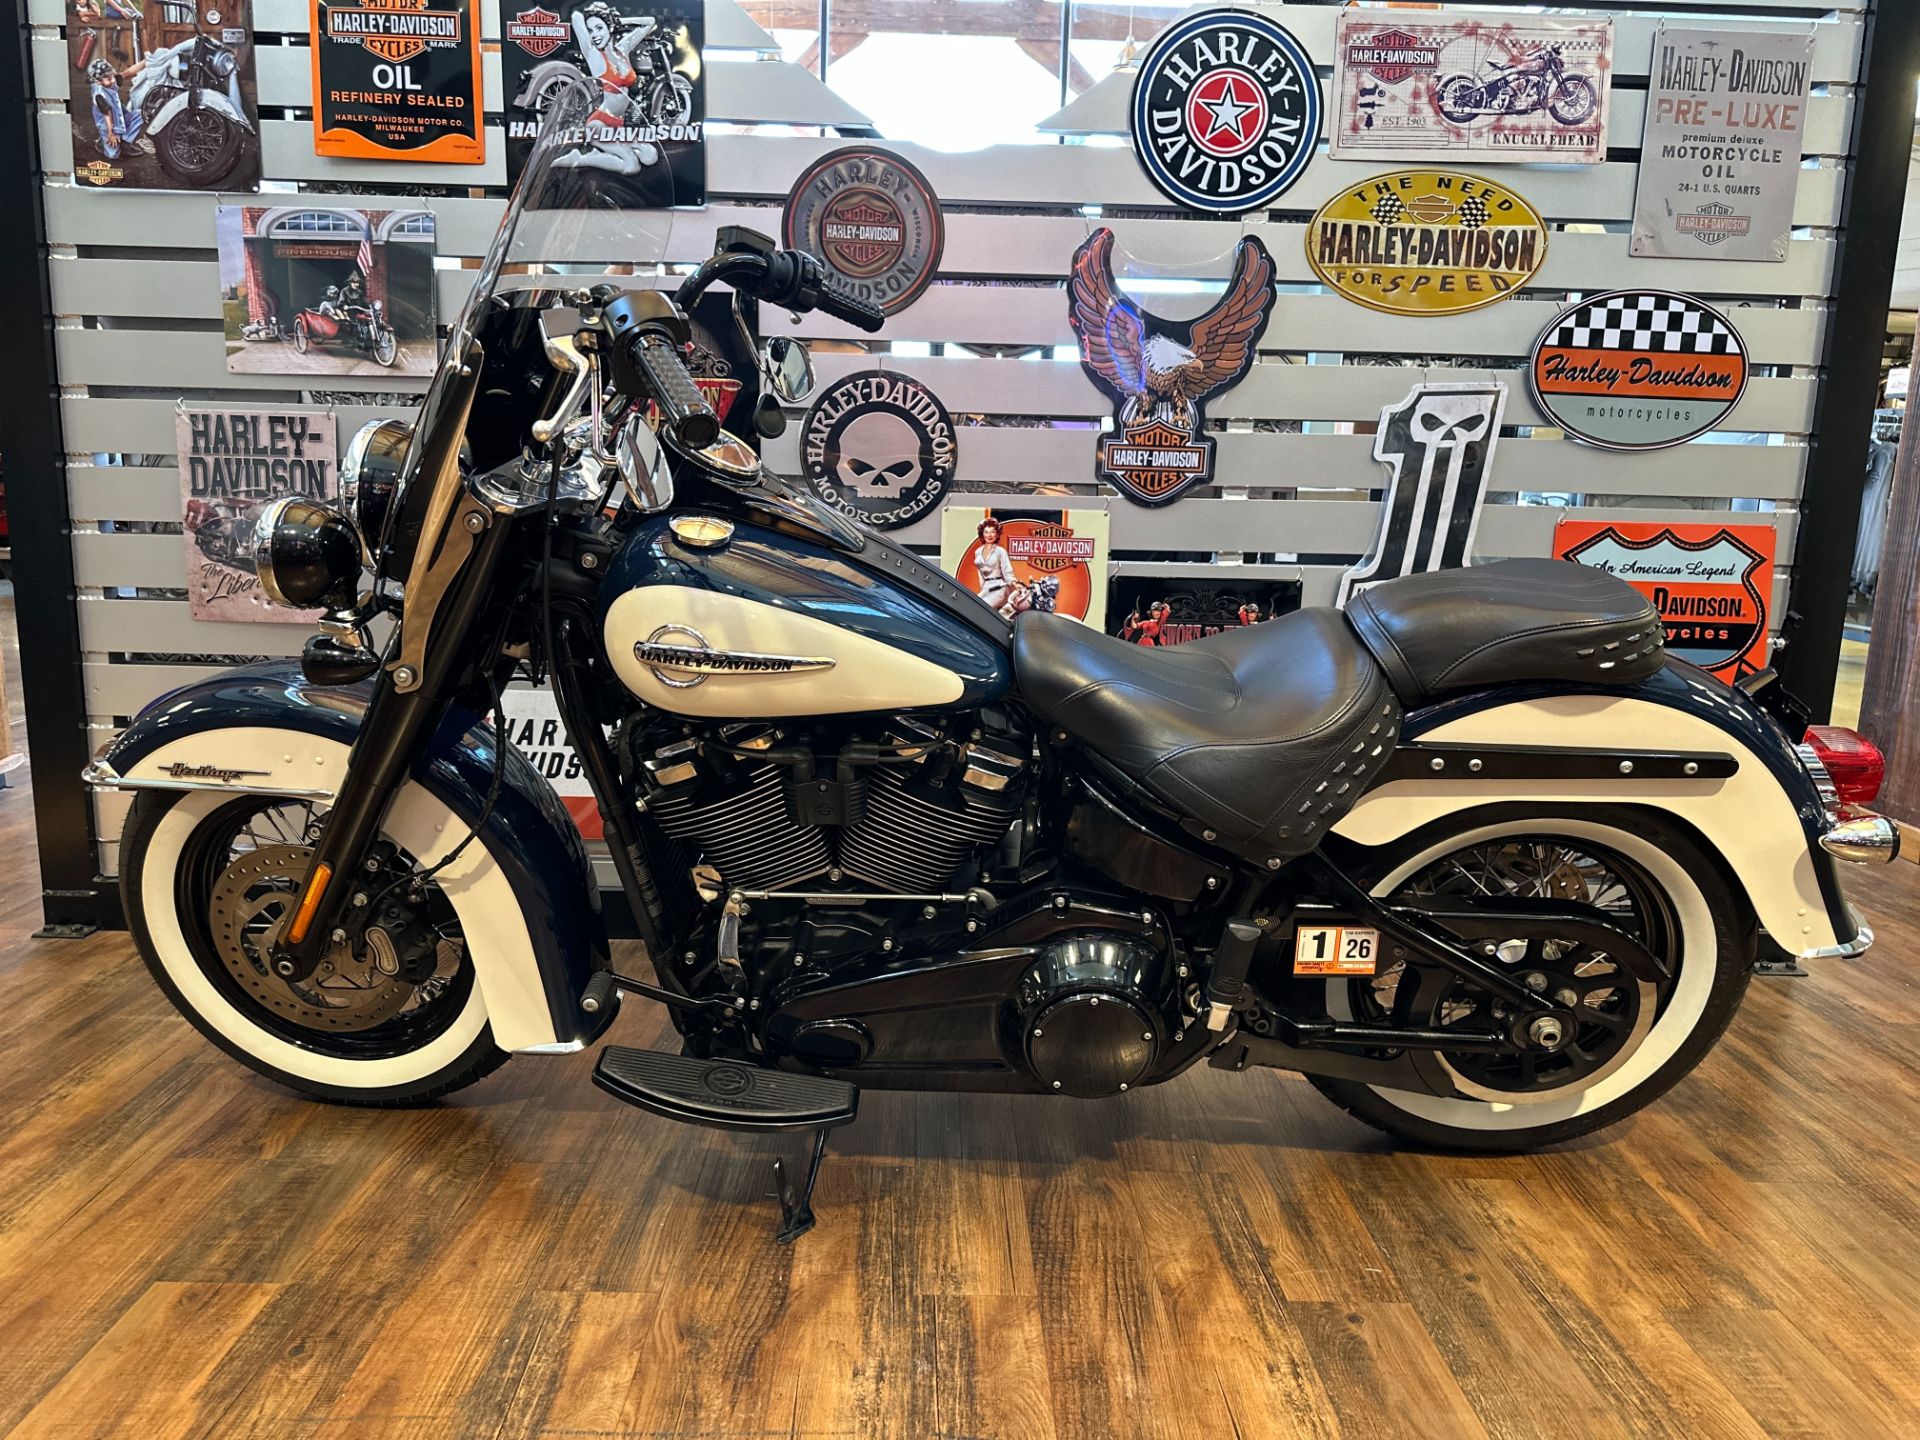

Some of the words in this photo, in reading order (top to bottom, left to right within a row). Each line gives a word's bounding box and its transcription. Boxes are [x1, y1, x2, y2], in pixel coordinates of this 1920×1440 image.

[367, 0, 419, 9] MOTOR
[333, 12, 456, 37] HARLEY-DAVIDSON
[523, 12, 553, 24] MOTOR
[511, 25, 566, 37] HARLEY-DAVIDSON
[1376, 33, 1412, 46] MOTOR
[332, 36, 362, 44] TRADE
[429, 41, 458, 49] MARK
[369, 39, 420, 58] CYCLES
[522, 39, 555, 51] CYCLES
[1351, 49, 1435, 64] HARLEY-DAVIDSON
[372, 63, 422, 91] OIL
[1374, 66, 1409, 81] CYCLES
[1659, 46, 1807, 96] HARLEY-DAVIDSON
[331, 91, 402, 105] REFINERY
[407, 94, 465, 108] SEALED
[335, 113, 415, 124] HARLEY-DAVIDSON
[417, 117, 448, 126] MOTOR
[449, 119, 465, 127] CO.
[1656, 98, 1799, 131] PRE-LUXE
[375, 124, 425, 133] MILWAUKEE
[388, 133, 406, 141] USA
[1493, 133, 1595, 146] KNUCKLEHEAD
[1682, 133, 1726, 143] premium
[1662, 145, 1782, 164] MOTORCYCLE
[1702, 165, 1735, 178] OIL
[1353, 176, 1413, 203] THE
[1437, 176, 1514, 212] NEED
[1678, 182, 1699, 193] 24-1
[1703, 184, 1721, 194] U.S.
[1725, 184, 1761, 196] QUARTS
[843, 208, 884, 223] MOTOR
[1700, 203, 1730, 216] MOTOR
[826, 223, 900, 242] HARLEY-DAVIDSON
[1678, 217, 1748, 231] HARLEY-DAVIDSON
[1697, 231, 1727, 243] CYCLES
[842, 243, 882, 261] CYCLES
[1319, 221, 1537, 272] HARLEY-DAVIDSON
[1336, 272, 1382, 285] FOR
[1381, 274, 1512, 293] SPEED
[1543, 353, 1732, 390] Harley-Davidson
[1587, 405, 1691, 421] motorcycles
[807, 377, 952, 469] HARLEY-DAVIDSON
[189, 413, 323, 456] HARLEY-
[1135, 428, 1180, 446] MOTOR
[1113, 449, 1199, 468] HARLEY-DAVIDSON
[189, 456, 328, 499] DAVIDSON
[1131, 471, 1177, 491] CYCLES
[813, 475, 942, 524] MOTORCYCLES
[1034, 526, 1068, 538] MOTOR
[1011, 540, 1091, 554] HARLEY-DAVIDSON
[201, 563, 223, 577] The
[1034, 558, 1067, 570] CYCLES
[1593, 559, 1615, 573] An
[1620, 560, 1684, 575] American
[1686, 561, 1736, 580] Legend
[640, 650, 794, 672] HARLEY-DAVIDSON
[170, 762, 242, 782] Heritage
[1312, 931, 1327, 958] 1
[1346, 939, 1371, 958] 26
